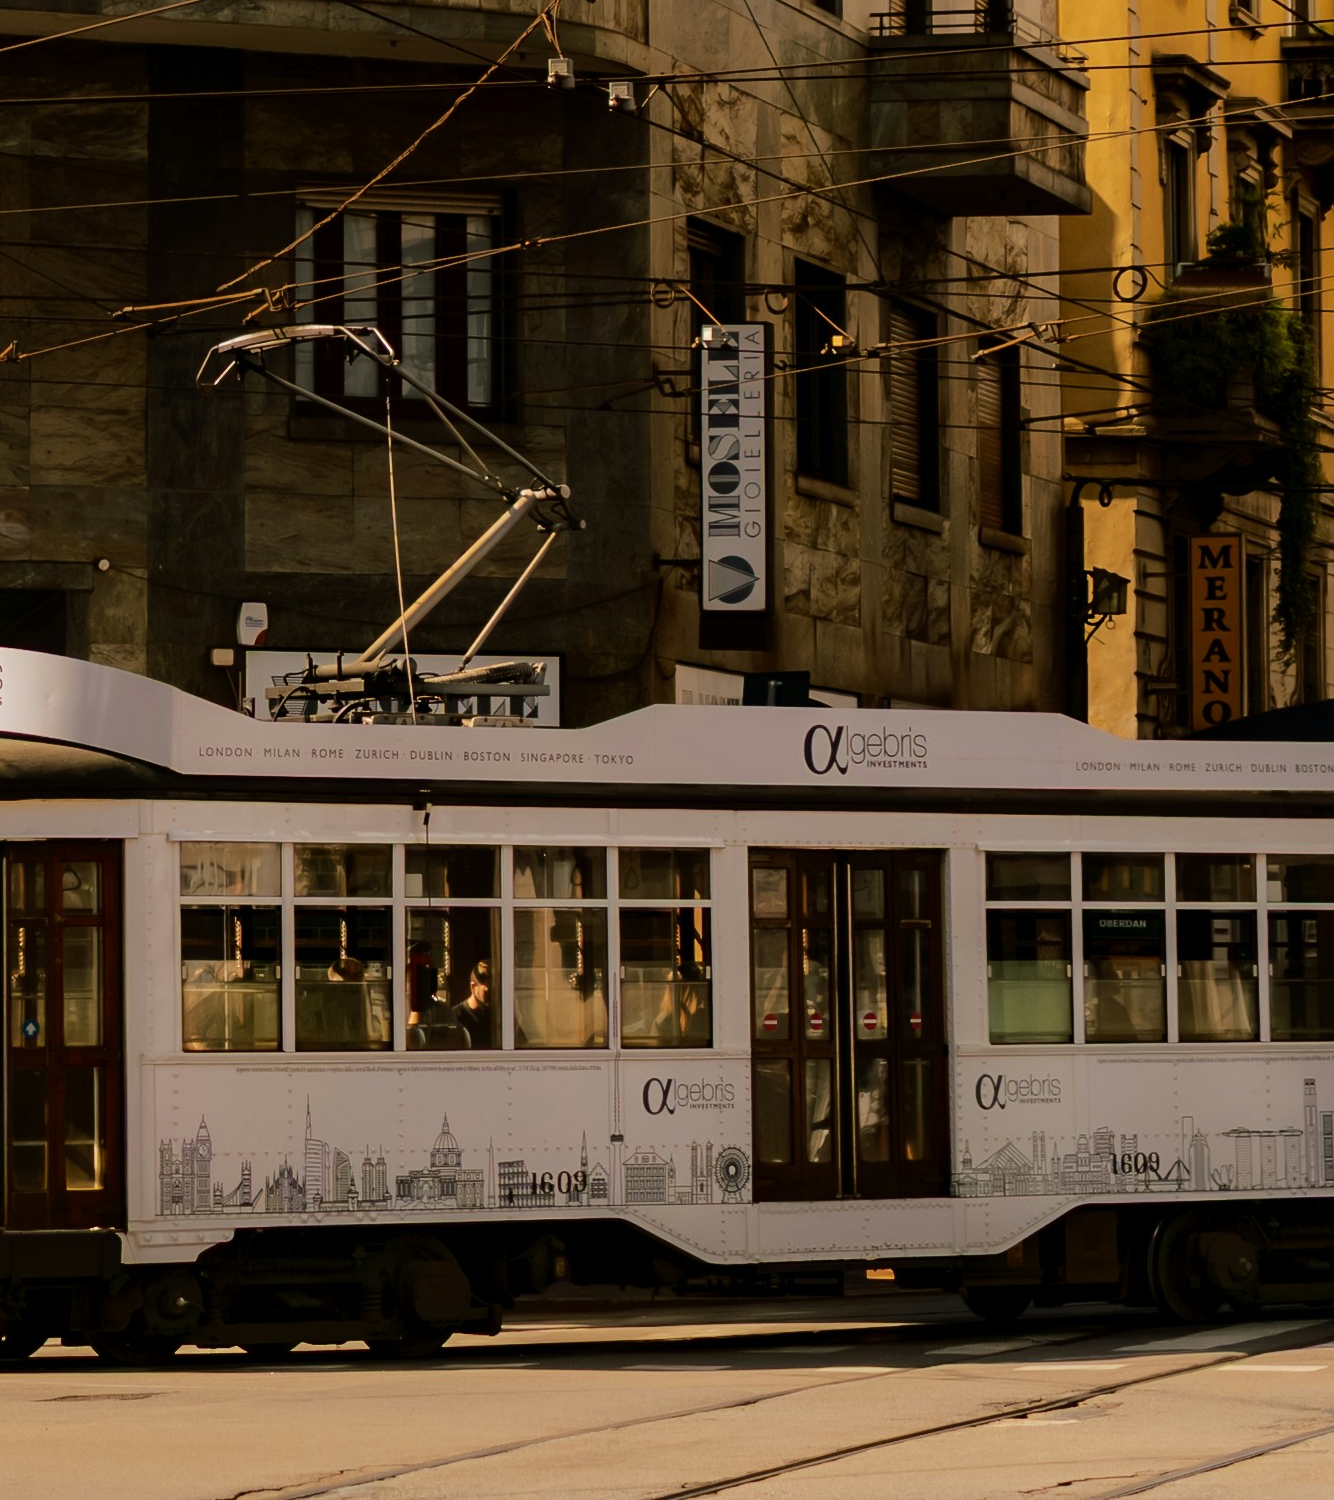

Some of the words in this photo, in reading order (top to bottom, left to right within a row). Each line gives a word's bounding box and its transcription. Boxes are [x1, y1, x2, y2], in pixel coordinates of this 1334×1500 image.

[744, 331, 762, 538] GIOIELLERIA
[1197, 544, 1234, 727] MERANO
[199, 747, 252, 757] LONDON
[263, 748, 300, 758] MILAN
[311, 748, 344, 759] ROME
[355, 749, 399, 759] ZURICH
[410, 751, 453, 760] DUBLIN
[463, 752, 511, 762] BOSTON
[520, 752, 584, 763] SINGAPORE
[594, 754, 635, 765] TOKYO
[867, 760, 928, 768] INVESTMENTS
[1076, 762, 1121, 771] LONDON
[1129, 763, 1160, 772] MILAN
[1168, 763, 1196, 772] ROME
[1205, 763, 1243, 772] ZURICH
[1250, 764, 1287, 773] DUBLIN
[1295, 764, 1334, 773] BOSTON
[1110, 1151, 1160, 1174] 1609
[531, 1170, 587, 1194] 1609
